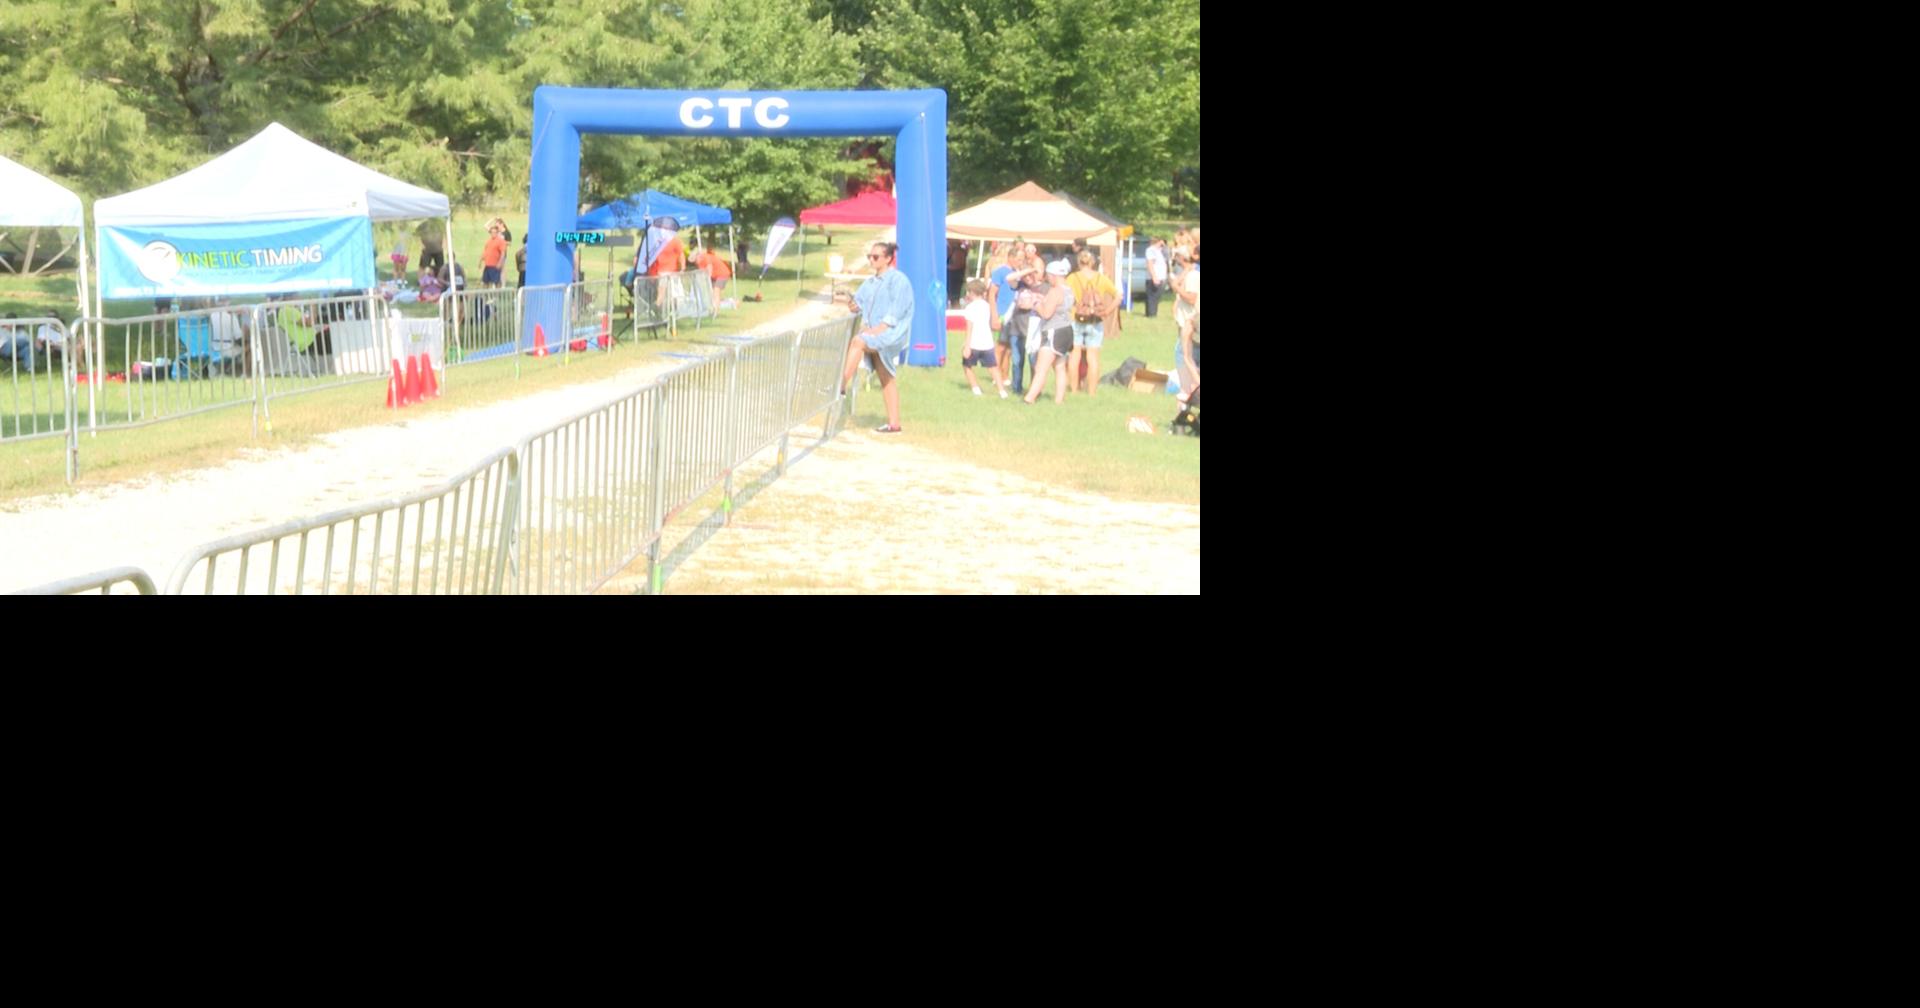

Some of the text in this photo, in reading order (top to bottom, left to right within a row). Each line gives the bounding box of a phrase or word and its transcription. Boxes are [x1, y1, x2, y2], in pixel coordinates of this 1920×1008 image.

[679, 98, 790, 129] CTC
[177, 245, 322, 268] KINETIC TIMING
